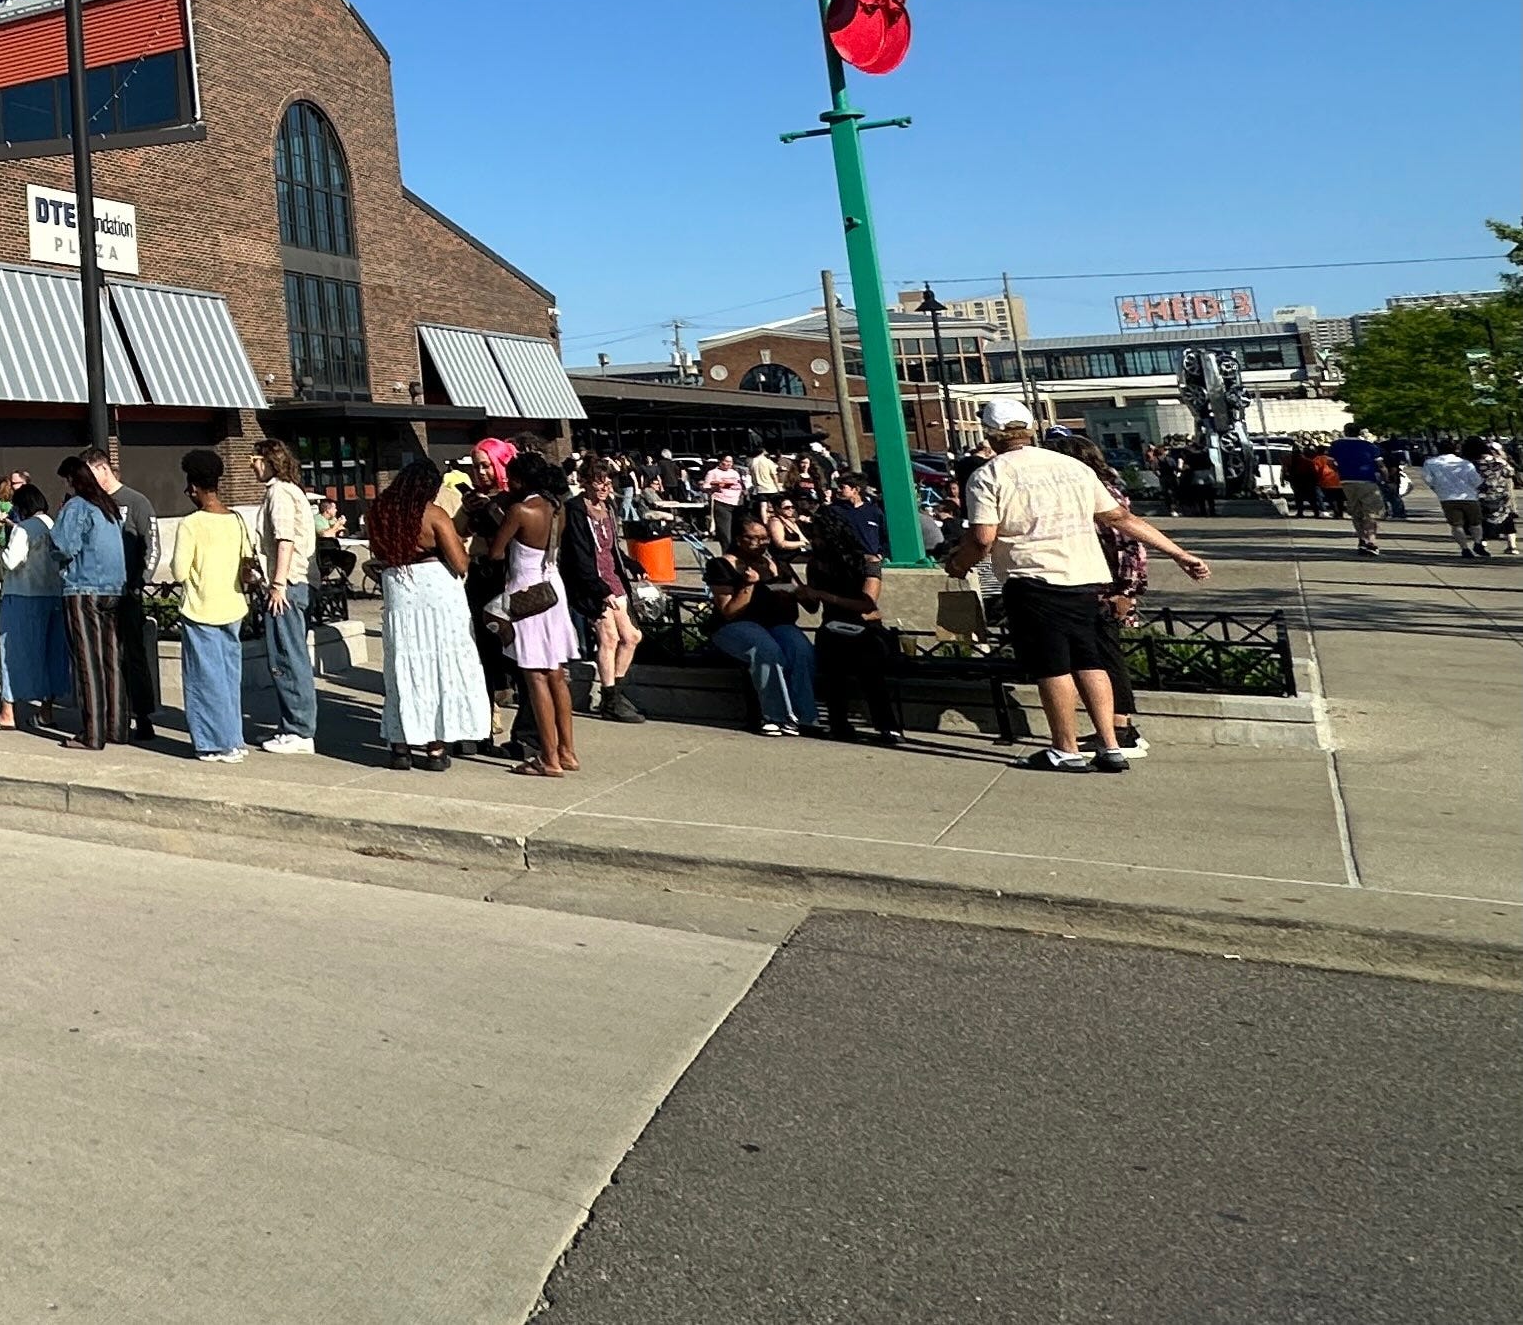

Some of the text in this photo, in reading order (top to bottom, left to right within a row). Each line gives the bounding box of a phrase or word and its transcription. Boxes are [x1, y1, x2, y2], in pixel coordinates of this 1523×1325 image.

[35, 196, 133, 238] DTE ndation
[54, 236, 118, 260] PLZA
[1120, 291, 1253, 324] SHED 3
